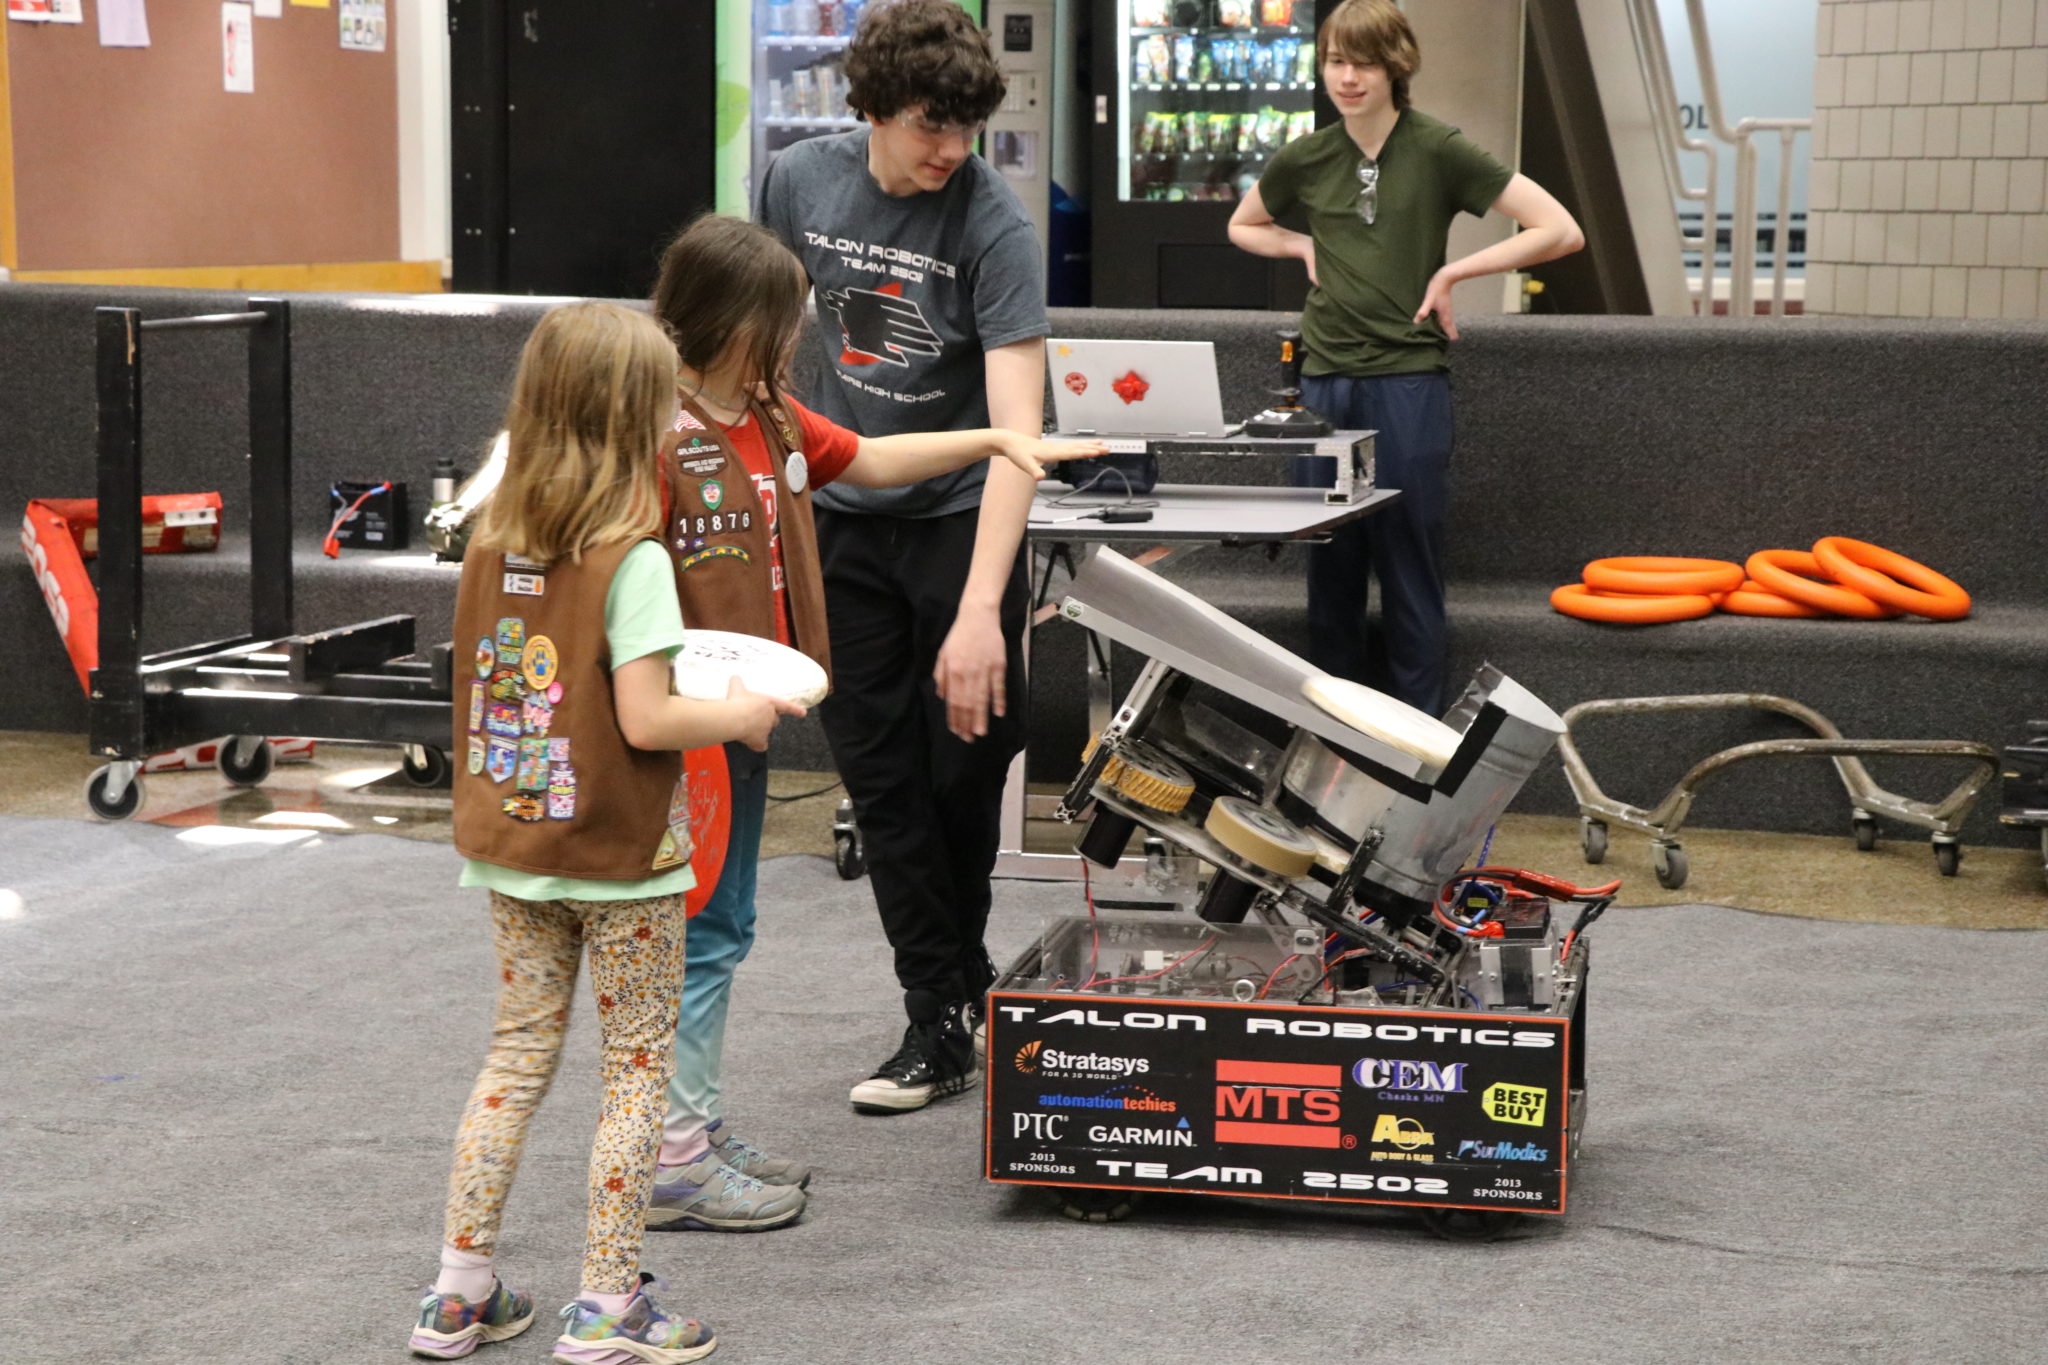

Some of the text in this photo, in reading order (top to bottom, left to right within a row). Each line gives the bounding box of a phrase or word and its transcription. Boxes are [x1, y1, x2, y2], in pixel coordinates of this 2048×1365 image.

[804, 231, 956, 279] TALON ROBOTICS
[841, 256, 924, 284] TEAM 2502
[864, 383, 891, 398] HIGH
[893, 389, 946, 403] SCHOOL
[1000, 1006, 1556, 1048] TALON ROBOTICS
[1042, 1049, 1150, 1076] Stratasys
[1042, 1070, 1060, 1078] FOR
[1086, 1073, 1118, 1081] WORLD
[1352, 1057, 1469, 1093] CEM
[1039, 1094, 1177, 1112] automationtechies
[1216, 1085, 1341, 1123] MTS
[1493, 1088, 1545, 1108] BEST
[1493, 1104, 1539, 1122] BUY
[1013, 1112, 1064, 1141] PTC
[1088, 1125, 1193, 1147] GARMIN
[1030, 1152, 1056, 1162] 2013
[1471, 1139, 1549, 1162] SurModics
[1010, 1162, 1076, 1174] SPONSORS
[1096, 1160, 1449, 1195] TEAM 2502
[1495, 1178, 1522, 1188] 2013
[1473, 1188, 1543, 1201] SPONSORS
